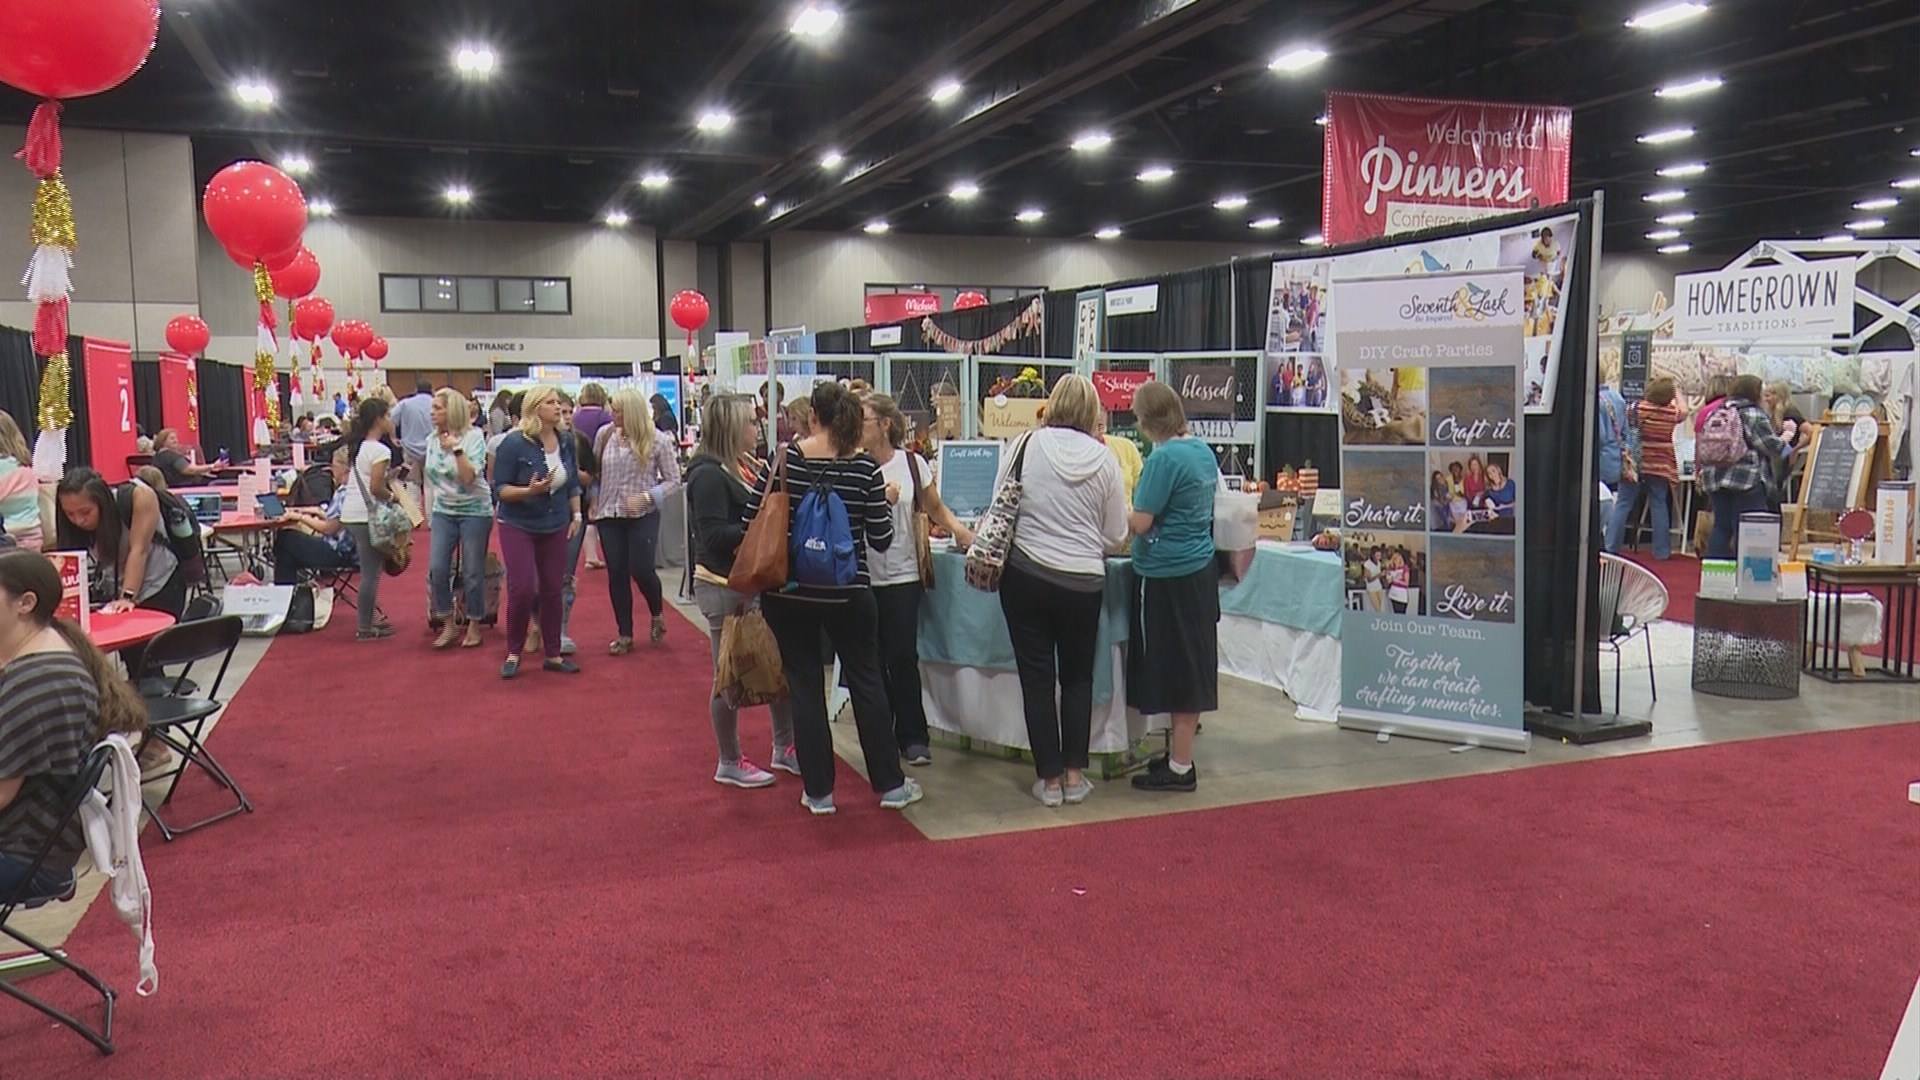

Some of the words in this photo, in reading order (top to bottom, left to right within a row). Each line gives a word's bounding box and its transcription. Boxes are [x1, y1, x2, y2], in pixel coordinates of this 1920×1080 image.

[1426, 121, 1512, 148] Welcome
[1516, 129, 1537, 149] to
[1361, 135, 1532, 215] Pinners
[1400, 290, 1459, 319] Seventh
[1464, 288, 1516, 317] Lark
[1687, 270, 1839, 317] HOMEGROWN
[1717, 319, 1797, 333] TRADITIONS
[465, 343, 516, 351] ENTRANCE
[519, 343, 525, 351] 3
[1360, 346, 1387, 360] DIY
[1391, 344, 1432, 359] Craft
[1436, 344, 1494, 357] Parties
[1181, 374, 1234, 401] blessed
[120, 388, 130, 432] 2
[991, 414, 1030, 428] Welcome
[1191, 421, 1237, 437] AMILY
[1436, 415, 1491, 446] Craft
[1493, 417, 1515, 439] it.
[1346, 498, 1400, 528] Share
[1403, 502, 1425, 524] it.
[1436, 584, 1485, 620] Live
[1488, 591, 1513, 613] it.
[1371, 618, 1403, 632] Join
[1407, 620, 1436, 636] Our
[1439, 625, 1486, 640] Team.
[1386, 643, 1462, 679] Together
[1378, 671, 1397, 685] we
[1401, 674, 1429, 689] can
[1433, 675, 1482, 696] create
[1356, 685, 1416, 713] crafting
[1421, 695, 1502, 720] memories.
